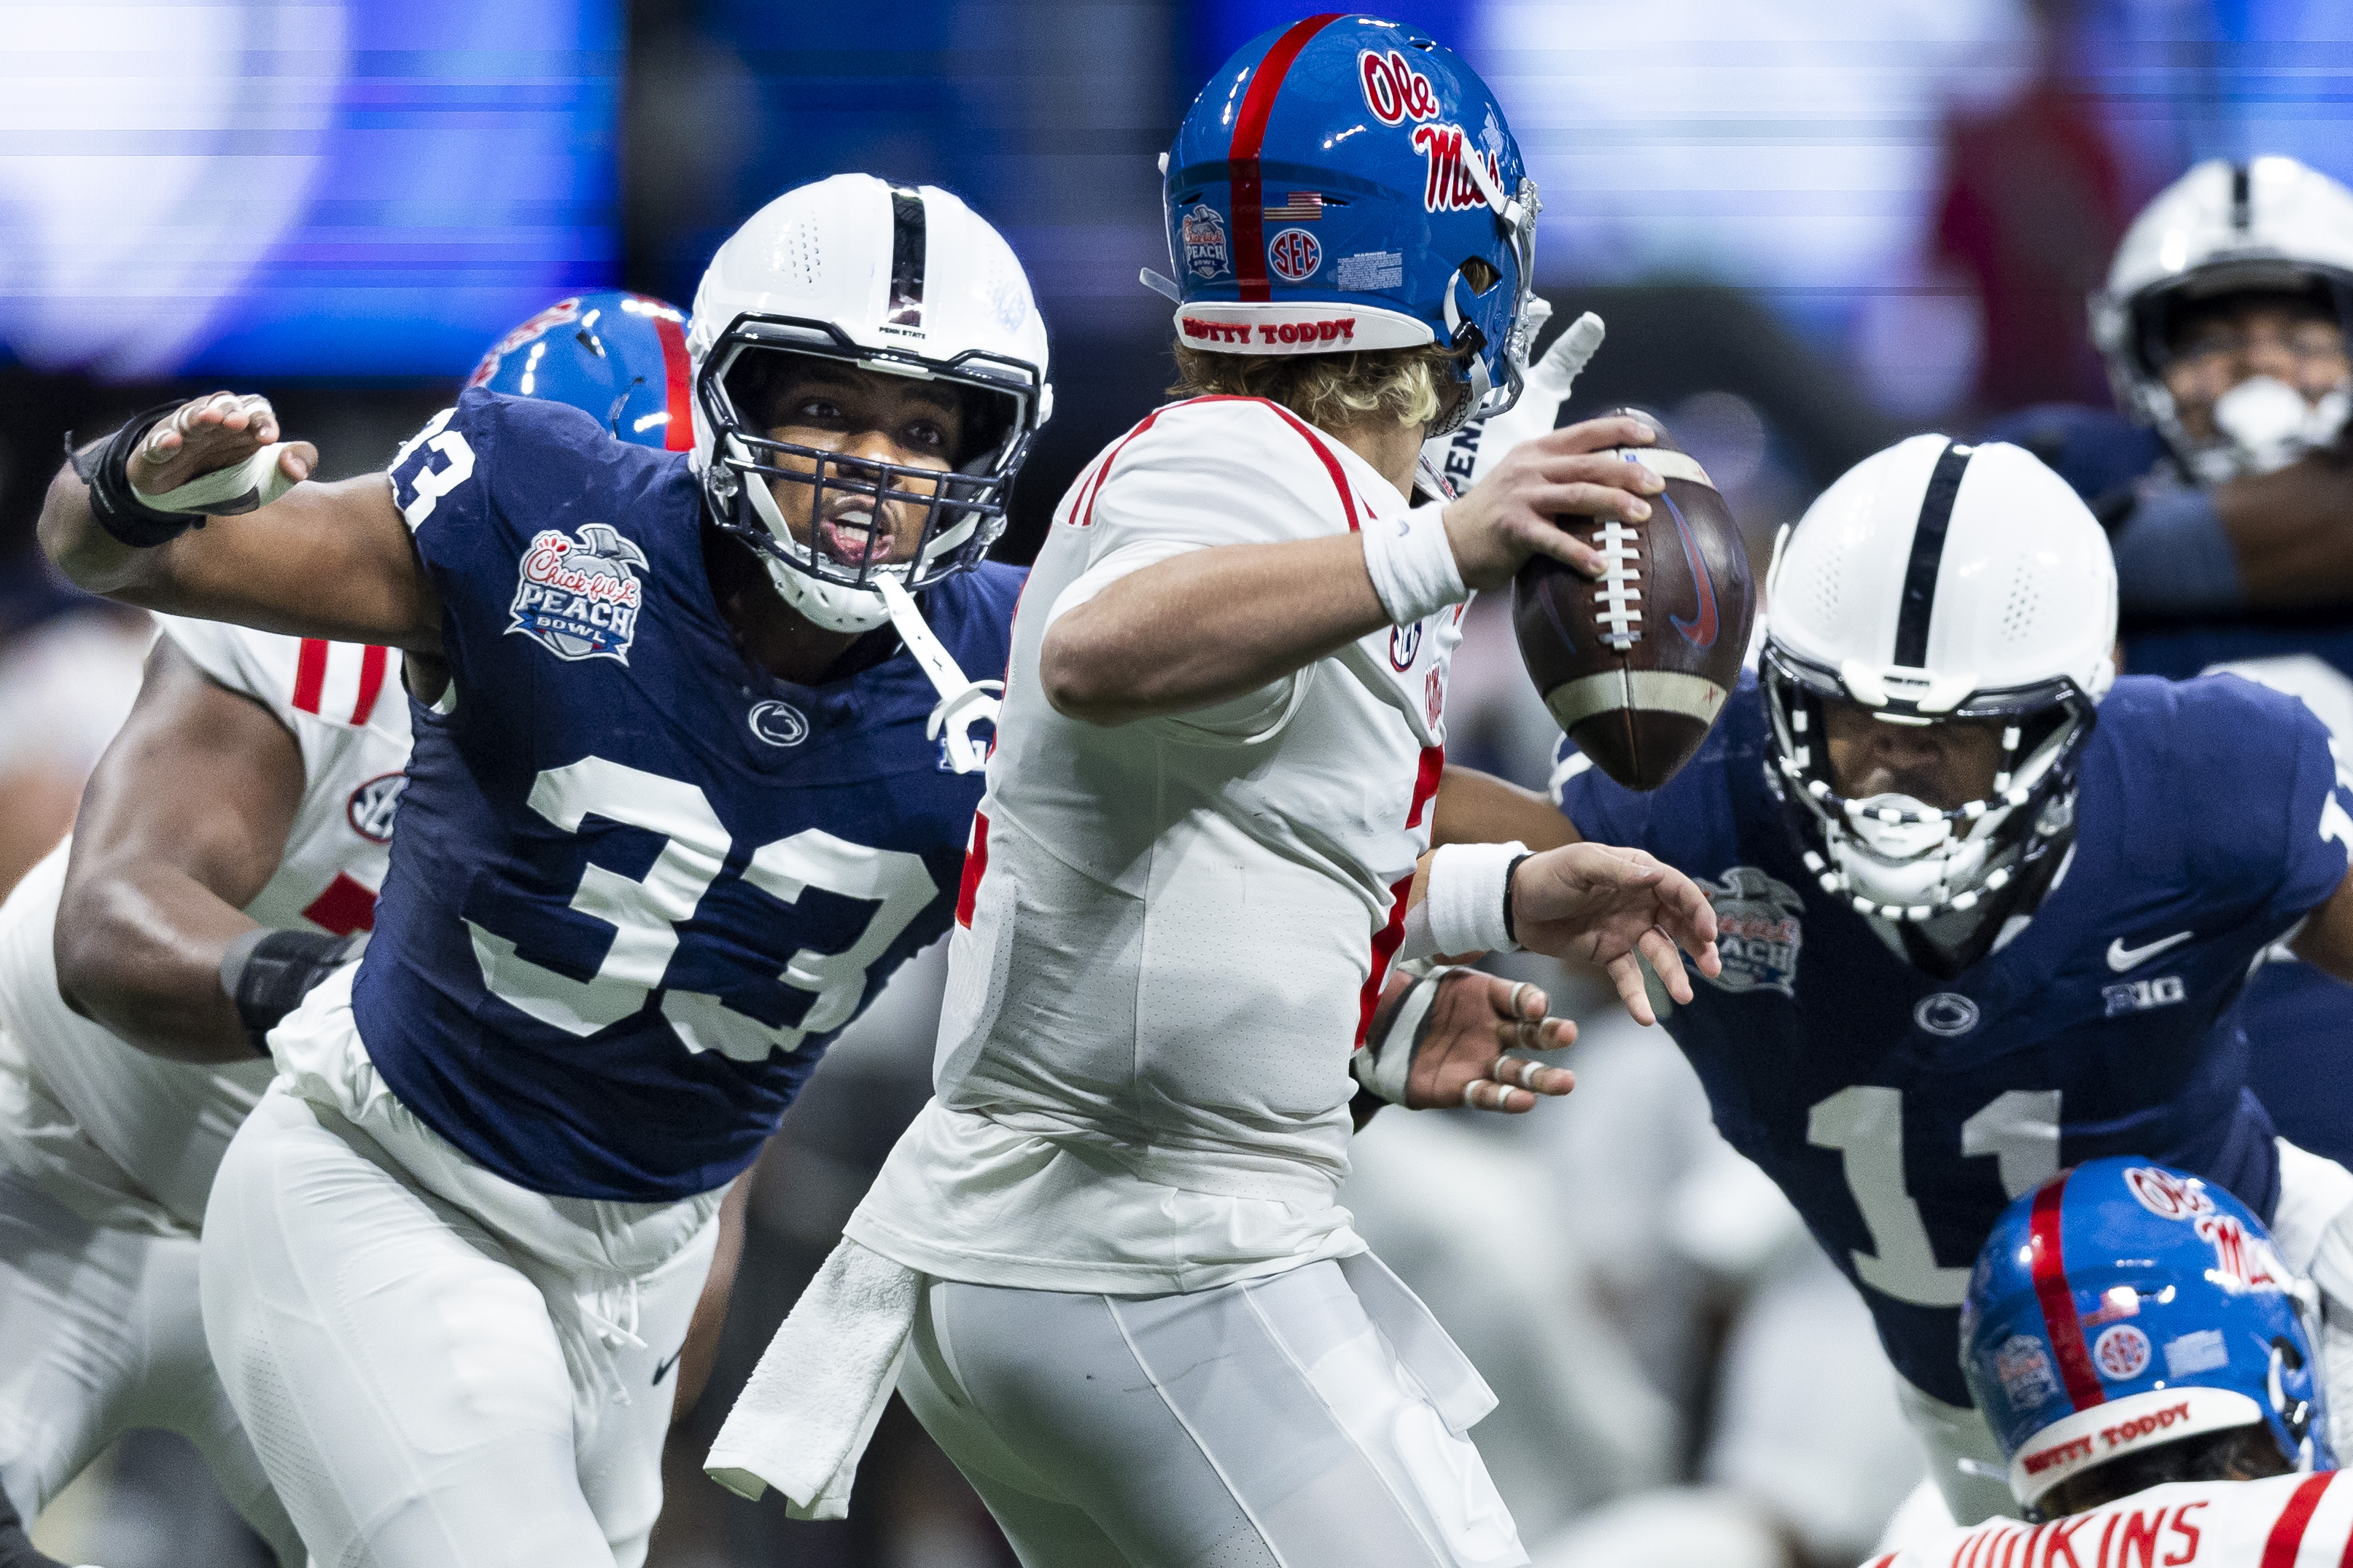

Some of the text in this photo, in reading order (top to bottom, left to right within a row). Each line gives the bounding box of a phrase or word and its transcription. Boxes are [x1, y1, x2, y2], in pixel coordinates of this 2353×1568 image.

[1359, 50, 1440, 125] Ole
[1412, 123, 1505, 214] Mi
[1186, 246, 1224, 261] PEACH
[1272, 232, 1318, 276] SEC
[1259, 319, 1356, 344] TODDY
[516, 583, 634, 640] PEACH
[536, 617, 607, 644] BOWL
[353, 777, 410, 838] SE
[461, 755, 940, 1063] 33
[1719, 936, 1796, 972] ACH
[1806, 1085, 2063, 1307] 11
